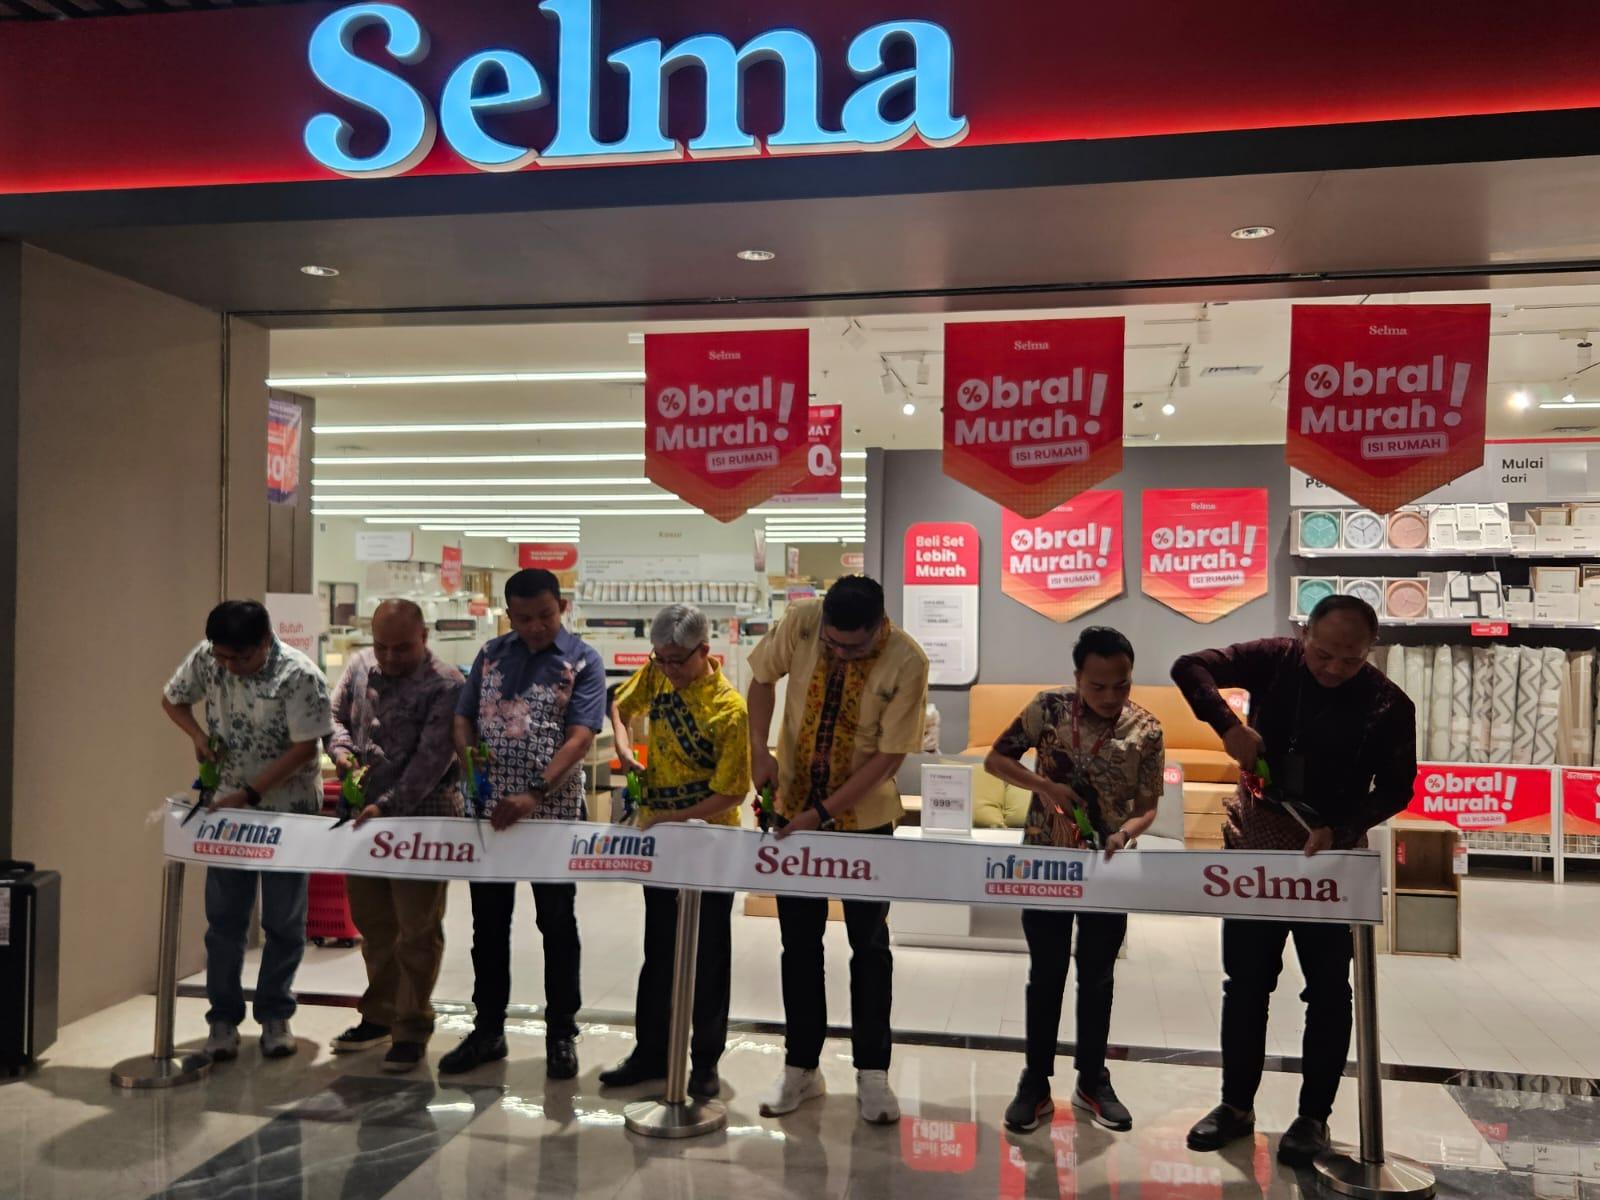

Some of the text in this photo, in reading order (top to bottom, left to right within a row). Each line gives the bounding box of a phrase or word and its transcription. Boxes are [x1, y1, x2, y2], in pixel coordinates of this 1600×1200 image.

[304, 0, 968, 177] Selma
[1369, 325, 1408, 336] Selma
[1014, 340, 1049, 351] Selma
[709, 351, 741, 361] Selma
[1368, 438, 1441, 453] ISI RUMAH
[712, 451, 773, 467] ISI RUMAH
[1016, 446, 1082, 461] ISI RUMAH
[1502, 457, 1543, 471] Mulai
[1501, 473, 1527, 484] dari
[916, 535, 964, 547] Beli Set
[916, 549, 957, 562] Lebih
[916, 564, 967, 577] Murah
[1205, 574, 1239, 583] RUMAH
[198, 818, 282, 846] informa
[195, 844, 274, 858] ELECTRONICS
[369, 831, 475, 863] Selma
[571, 832, 656, 857] informa
[571, 860, 649, 871] ELECTRONICS
[755, 845, 872, 881] Selma
[986, 854, 1084, 882] informa
[1202, 864, 1340, 902] Selma
[988, 884, 1080, 897] ELECTRONICS
